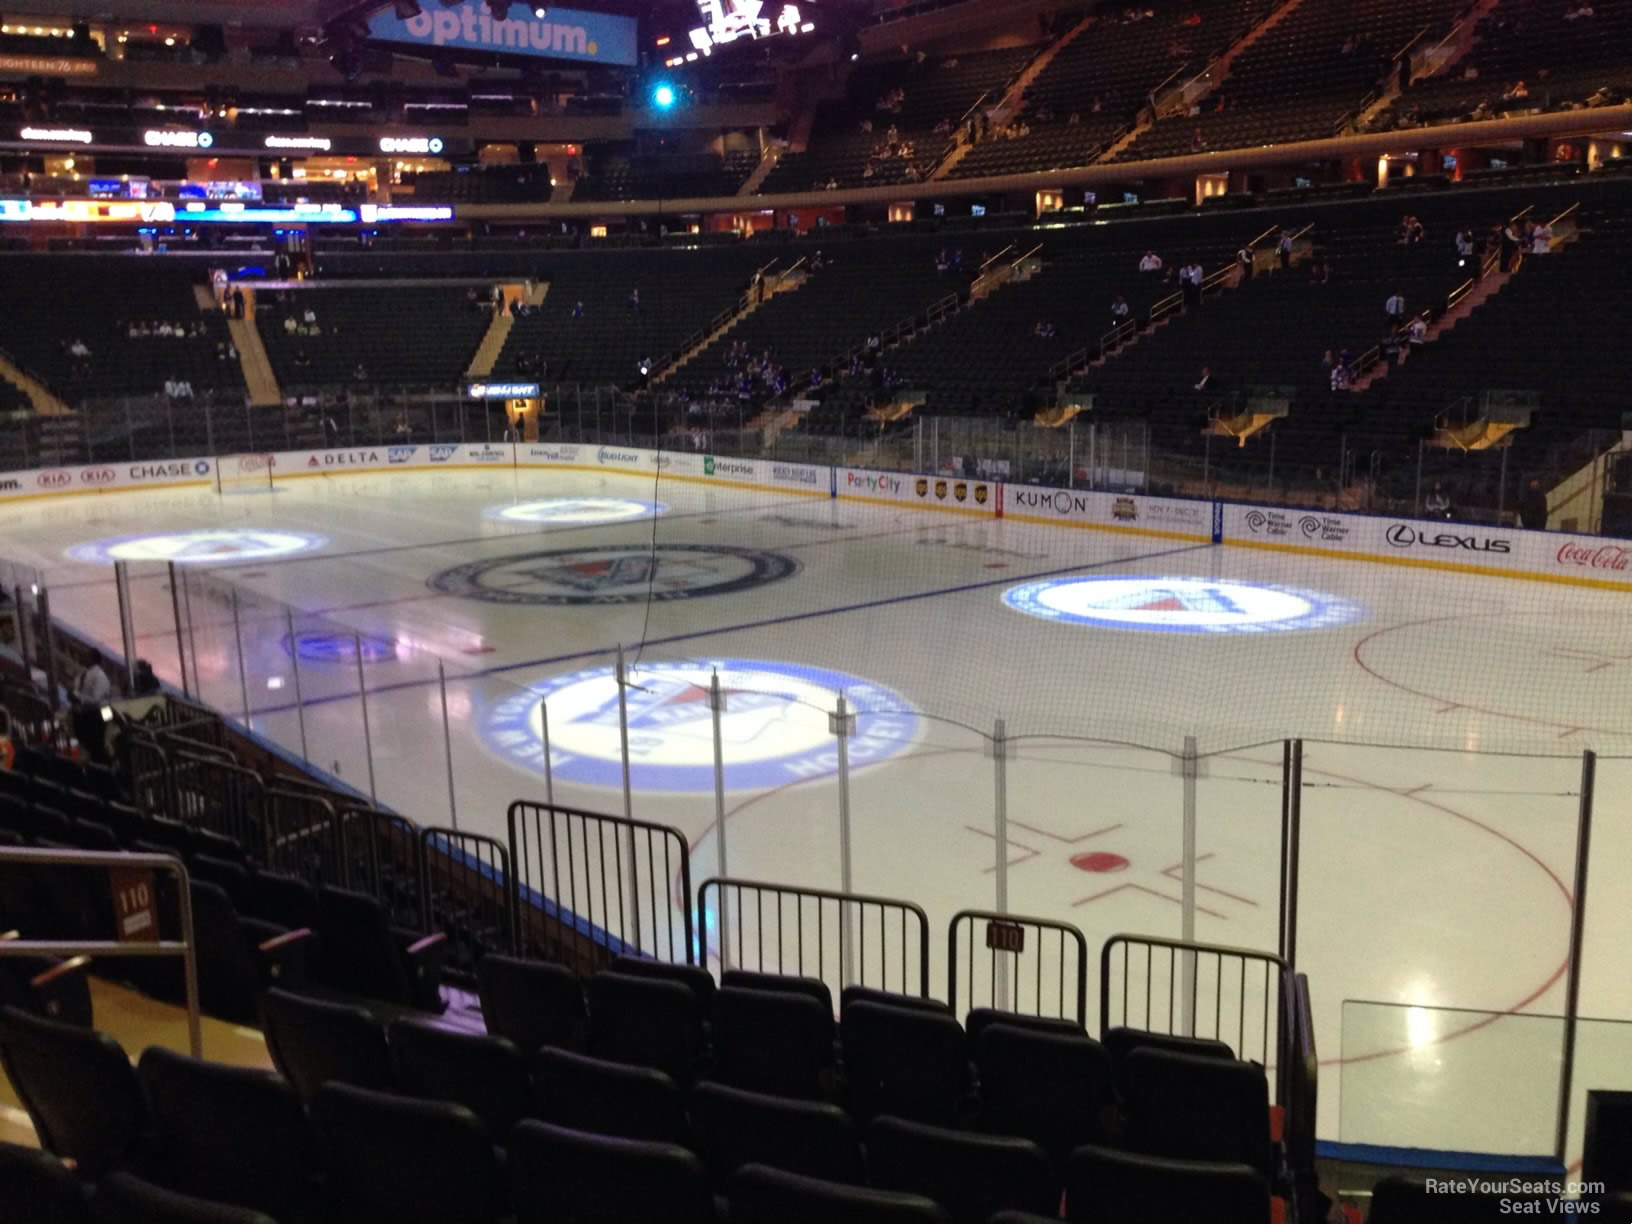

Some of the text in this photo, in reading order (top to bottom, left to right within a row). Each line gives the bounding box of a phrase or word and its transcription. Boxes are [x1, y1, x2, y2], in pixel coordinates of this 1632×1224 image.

[324, 452, 379, 465] DELTA
[130, 463, 192, 479] CHASE
[1016, 491, 1086, 514] KUMON
[1267, 512, 1285, 521] Time
[1267, 520, 1292, 529] Warner
[1322, 518, 1341, 526] Time
[1267, 527, 1287, 536] Cable
[1322, 525, 1349, 535] Warner
[1321, 532, 1344, 542] Cable
[1418, 532, 1511, 553] LEXUS
[120, 882, 149, 913] 110
